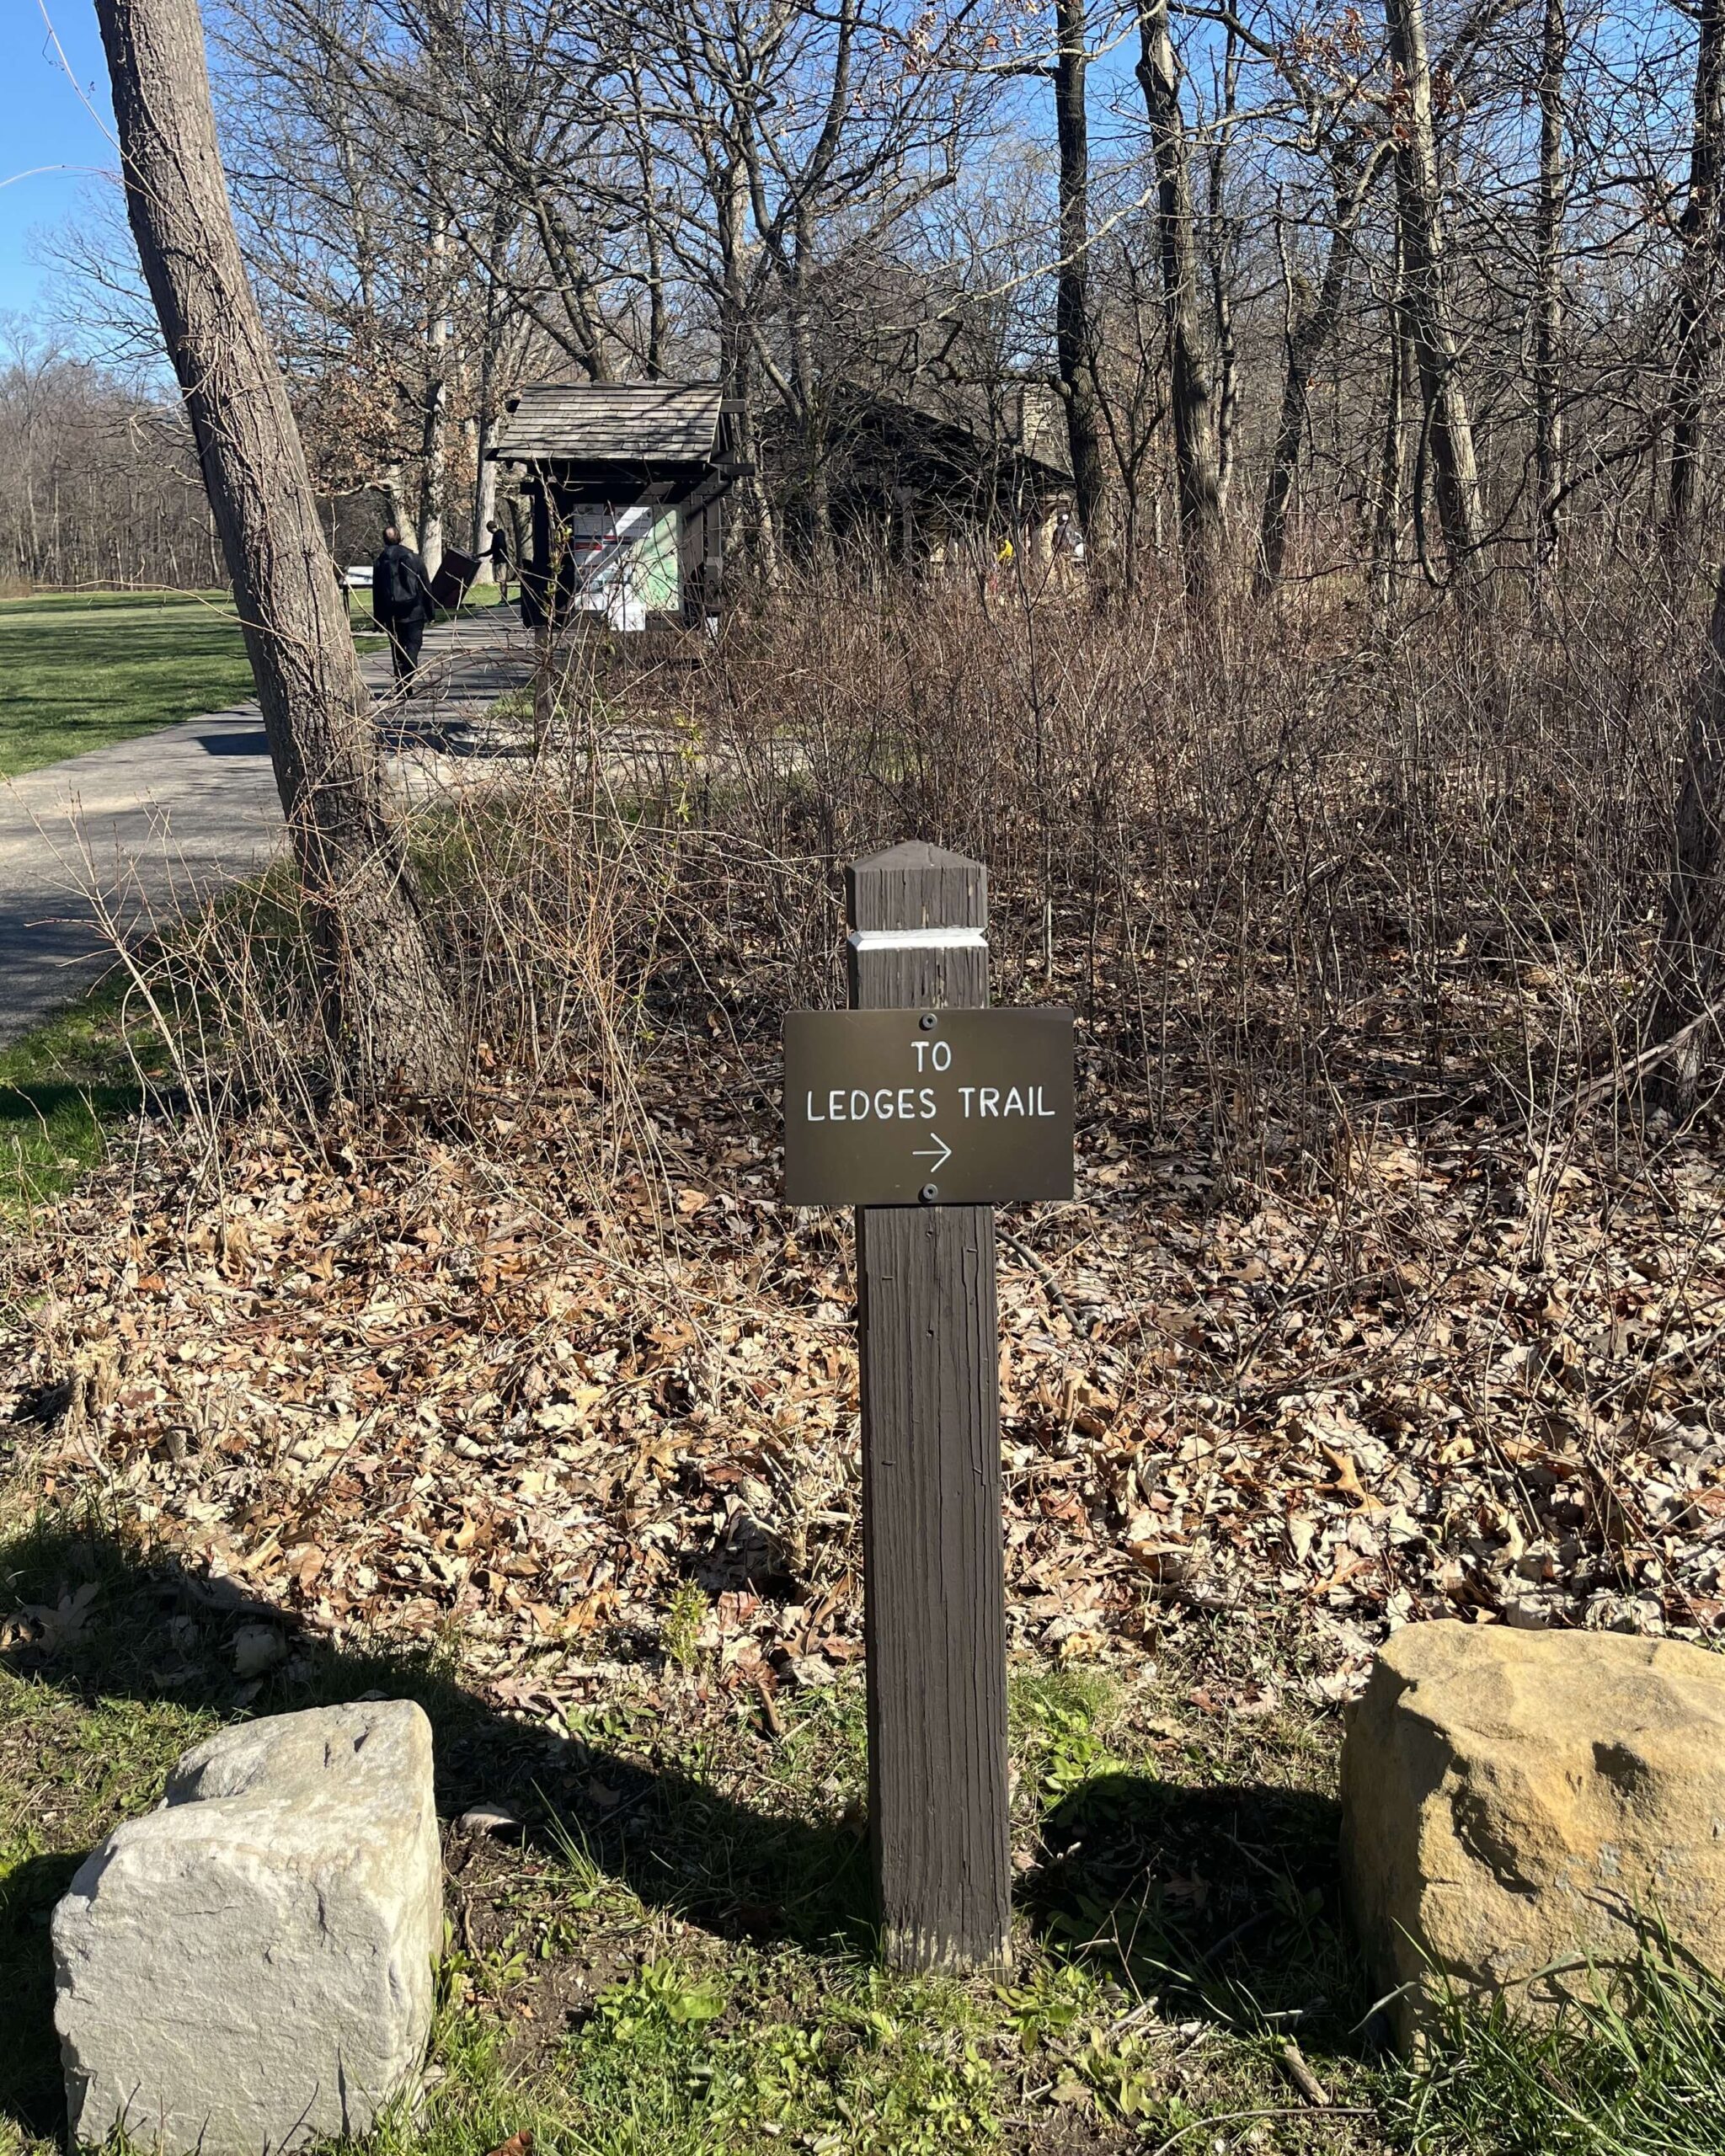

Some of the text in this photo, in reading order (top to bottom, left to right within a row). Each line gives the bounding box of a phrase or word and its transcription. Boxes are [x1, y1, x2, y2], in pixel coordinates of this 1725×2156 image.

[911, 1040, 952, 1072] TO
[807, 1086, 1055, 1122] LEDGES TRAIL
